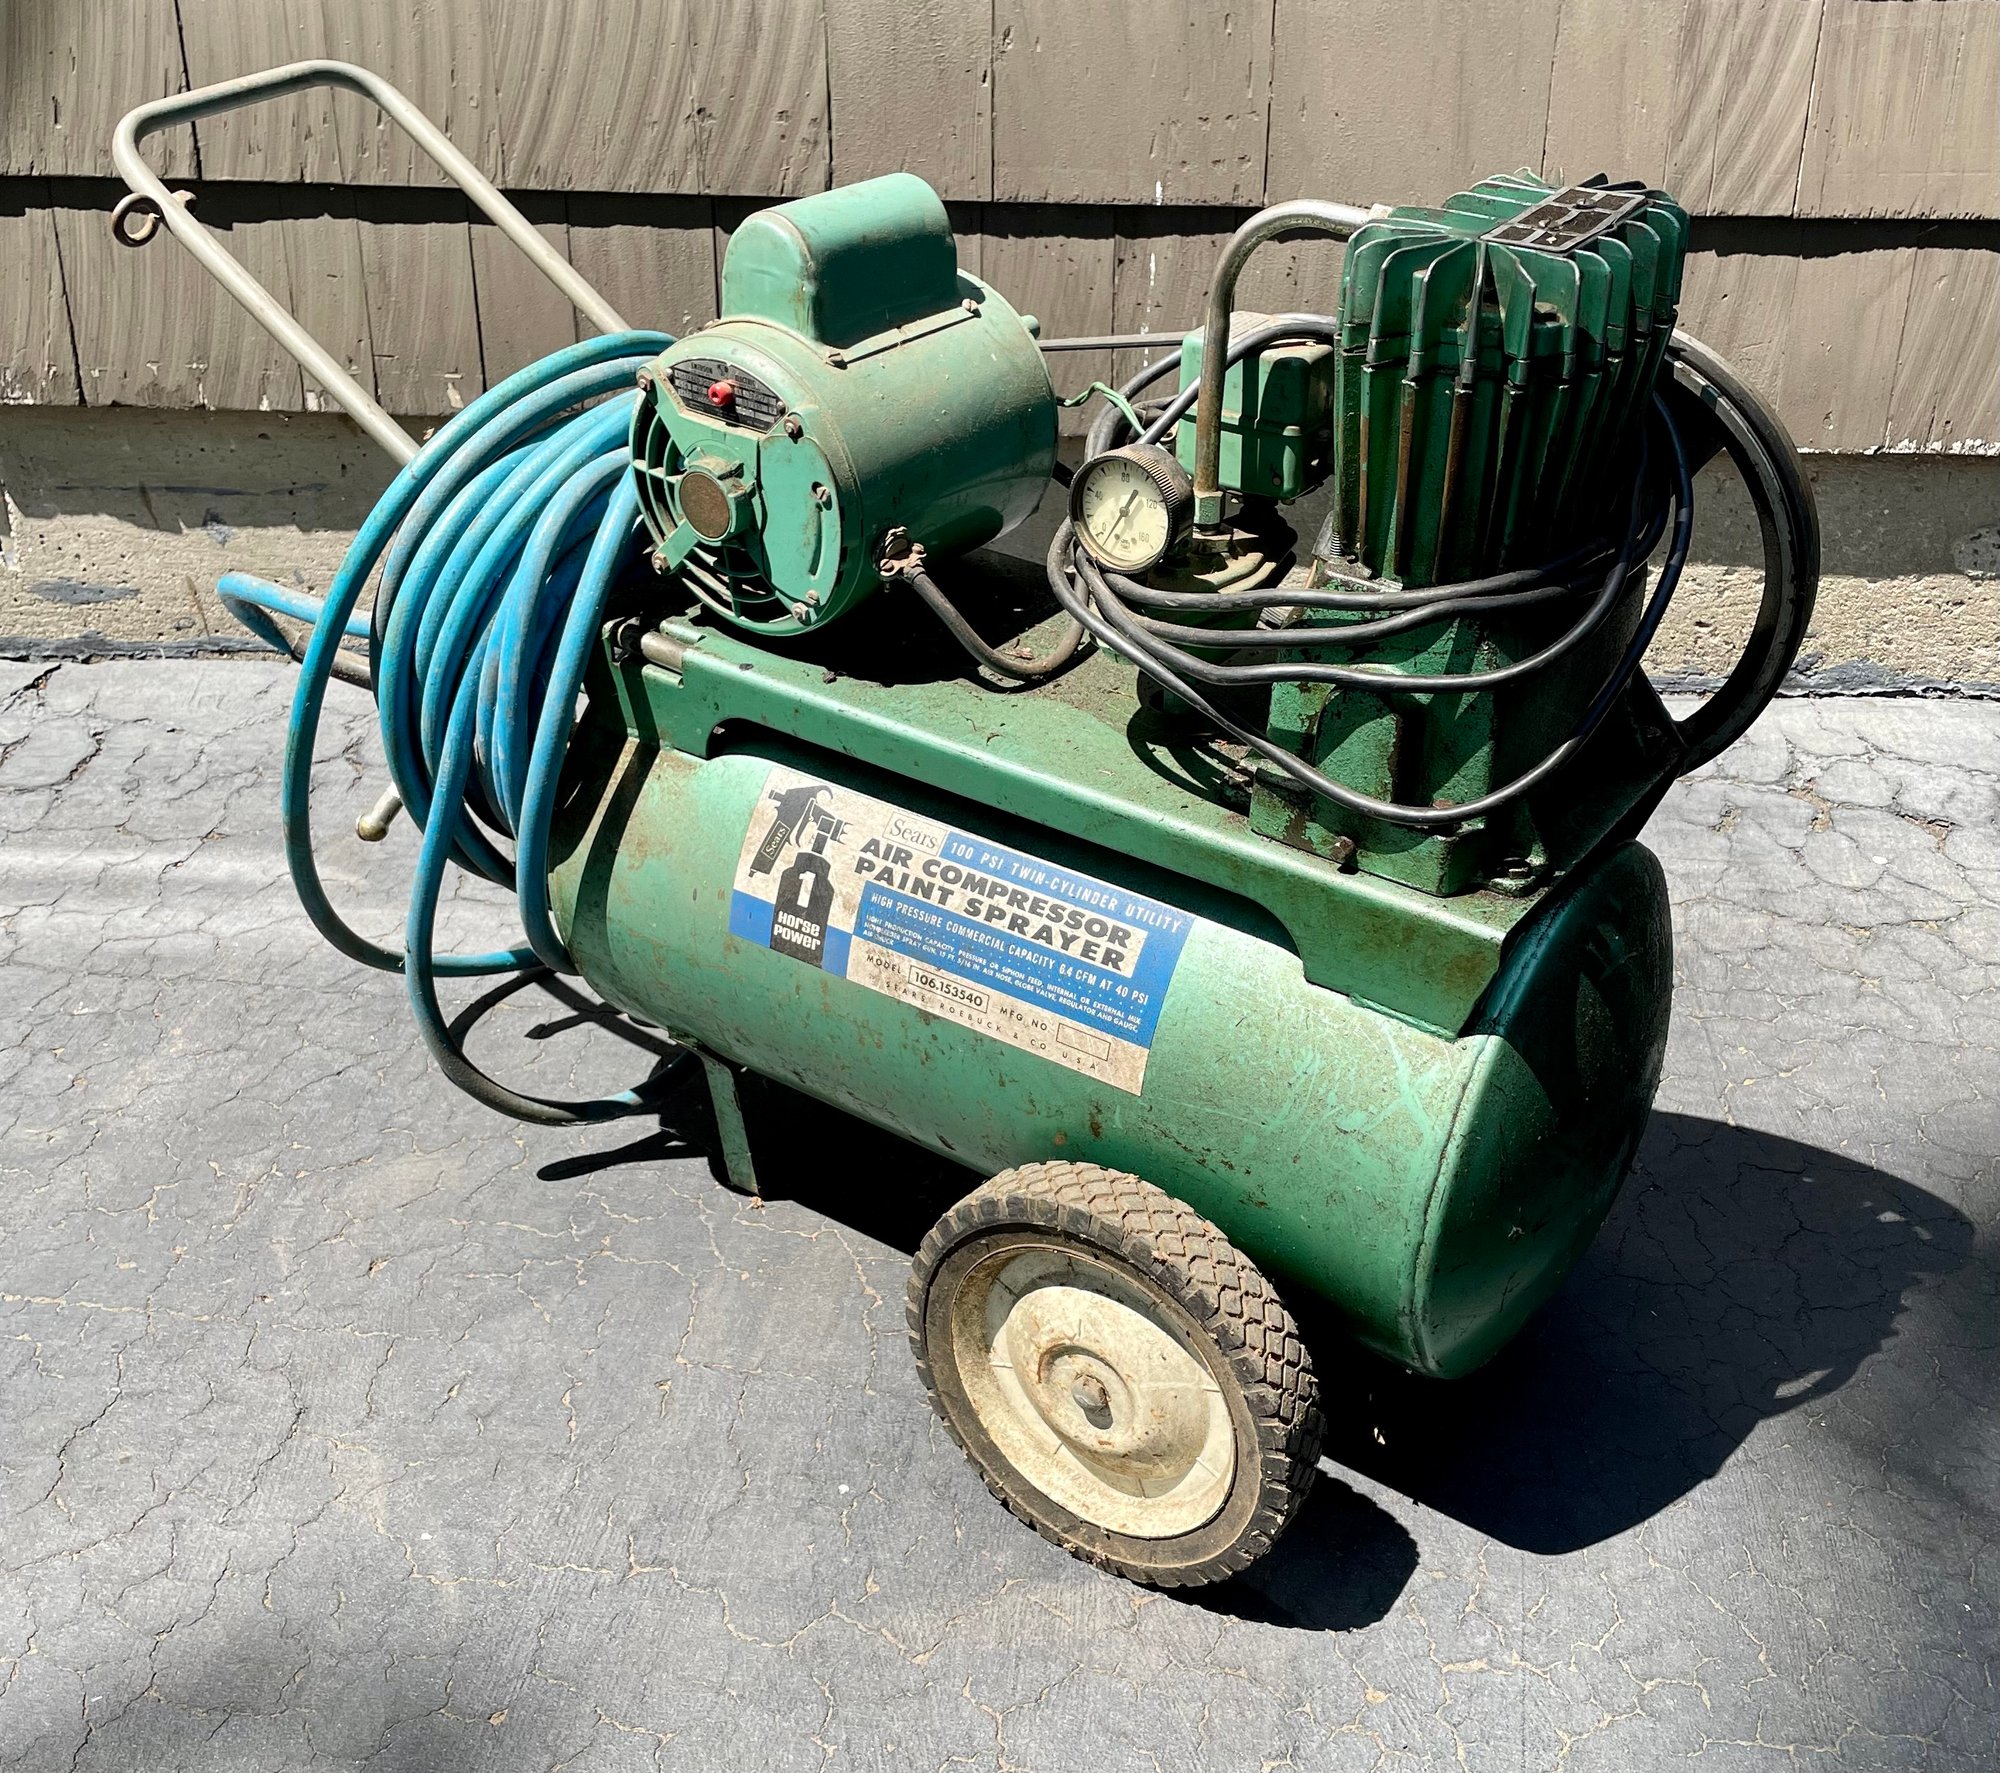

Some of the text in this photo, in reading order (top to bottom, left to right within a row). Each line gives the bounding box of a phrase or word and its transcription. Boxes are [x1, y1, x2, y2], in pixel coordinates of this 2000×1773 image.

[1095, 490, 1104, 501] 40
[1121, 472, 1130, 483] 80
[1146, 498, 1158, 510] 120
[1139, 532, 1150, 543] 160
[765, 826, 787, 856] Sears
[889, 818, 938, 849] Sears
[798, 870, 817, 908] 1
[854, 856, 1125, 972] PAINT SPRAYER
[860, 838, 1132, 949] AIR COMPRESSOR
[950, 842, 1183, 934] 100 PSI TWIN-CYLINDER UTILITY
[871, 892, 894, 909] HIGH
[896, 901, 944, 928] PRESSURE
[945, 920, 1005, 952] COMMERCIAL
[1008, 944, 1056, 970] CAPACITY
[1075, 969, 1097, 986] CFM
[1099, 978, 1113, 991] AT
[1115, 984, 1129, 998] 40
[1131, 990, 1149, 1005] PSI
[884, 920, 922, 941] PRODUCTION
[958, 949, 987, 966] PRESSURE
[989, 961, 999, 970] OR
[1001, 965, 1025, 980] SIPHON
[1047, 983, 1077, 1000] INTERNAL
[1080, 996, 1090, 1005] OR
[1093, 1001, 1125, 1018] EXTERNAL
[866, 954, 901, 974] MODEL
[914, 971, 983, 1007] 106.153540
[1000, 1006, 1023, 1021] MFG
[901, 936, 922, 948] SPRAY
[939, 950, 946, 958] 15
[957, 956, 971, 968] 5/16
[982, 967, 993, 977] AIR
[1014, 979, 1035, 992] GLOBE
[1058, 996, 1096, 1016] REGULATOR
[1096, 1012, 1113, 1022] AND
[886, 980, 926, 1002] SEARS
[939, 1003, 1001, 1033] ROEBUCK
[1013, 1032, 1018, 1040] &
